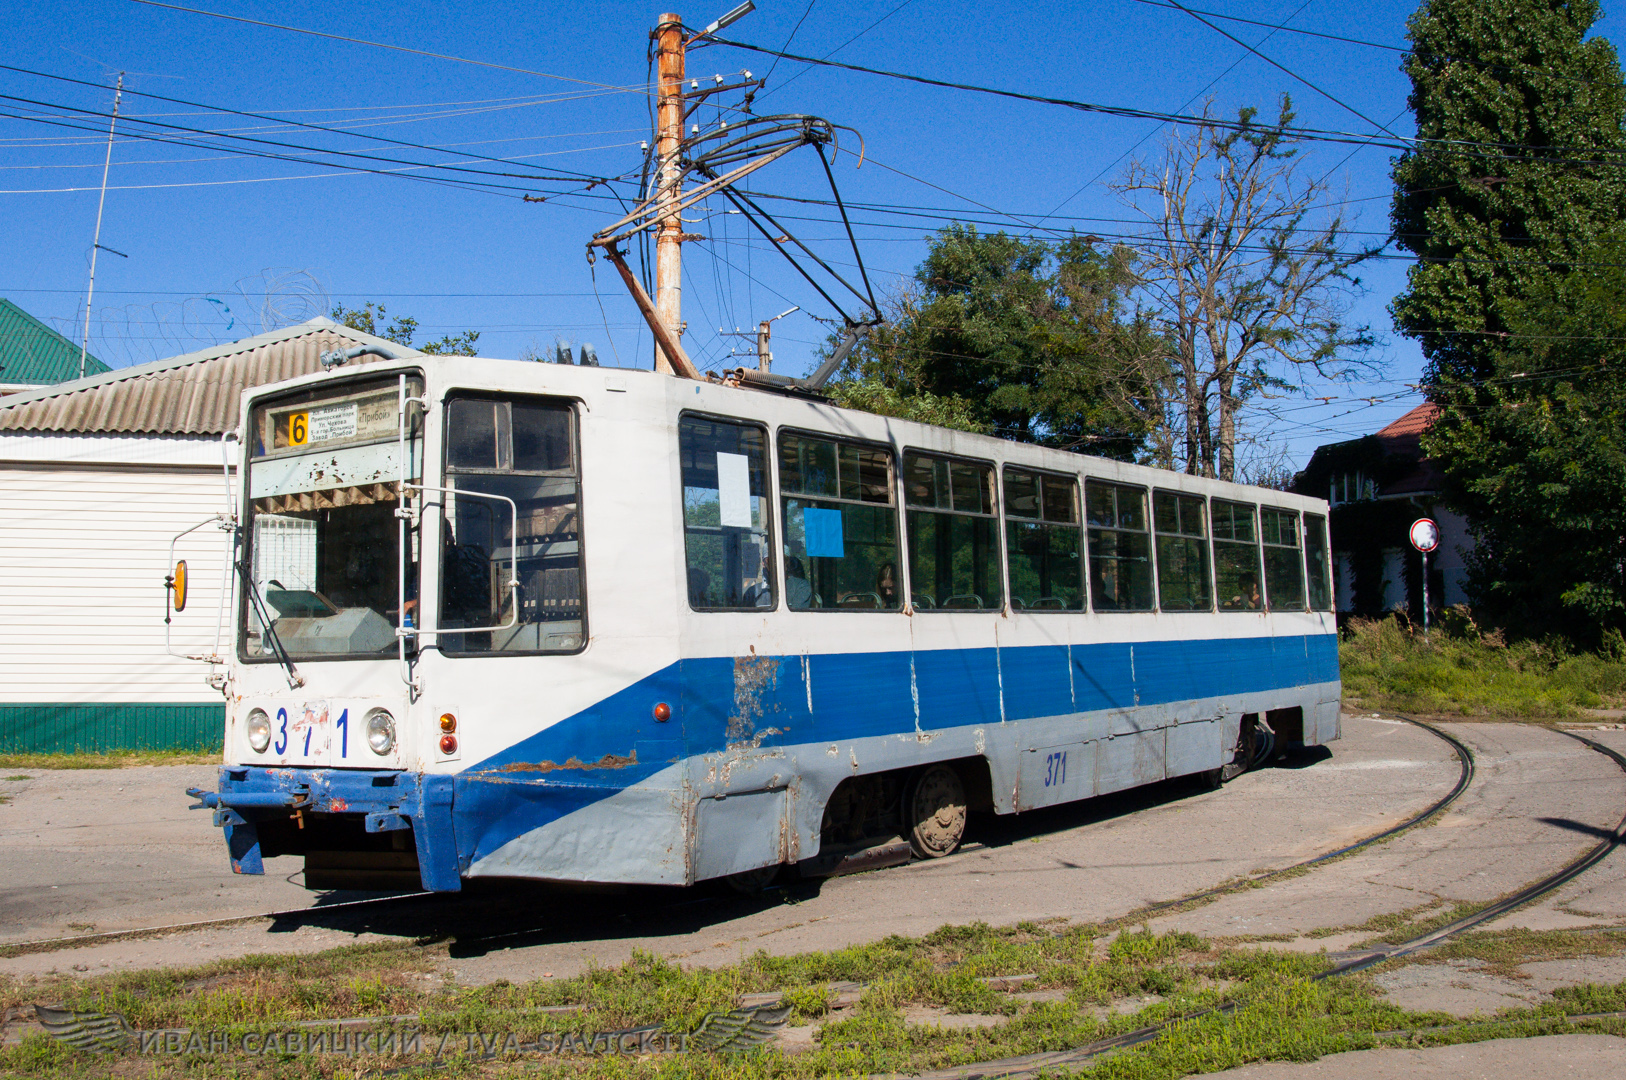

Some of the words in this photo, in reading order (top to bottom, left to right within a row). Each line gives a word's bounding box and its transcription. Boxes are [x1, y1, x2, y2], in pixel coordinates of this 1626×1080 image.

[292, 414, 305, 443] 6
[327, 419, 347, 427] Чехова
[1044, 751, 1067, 787] 371
